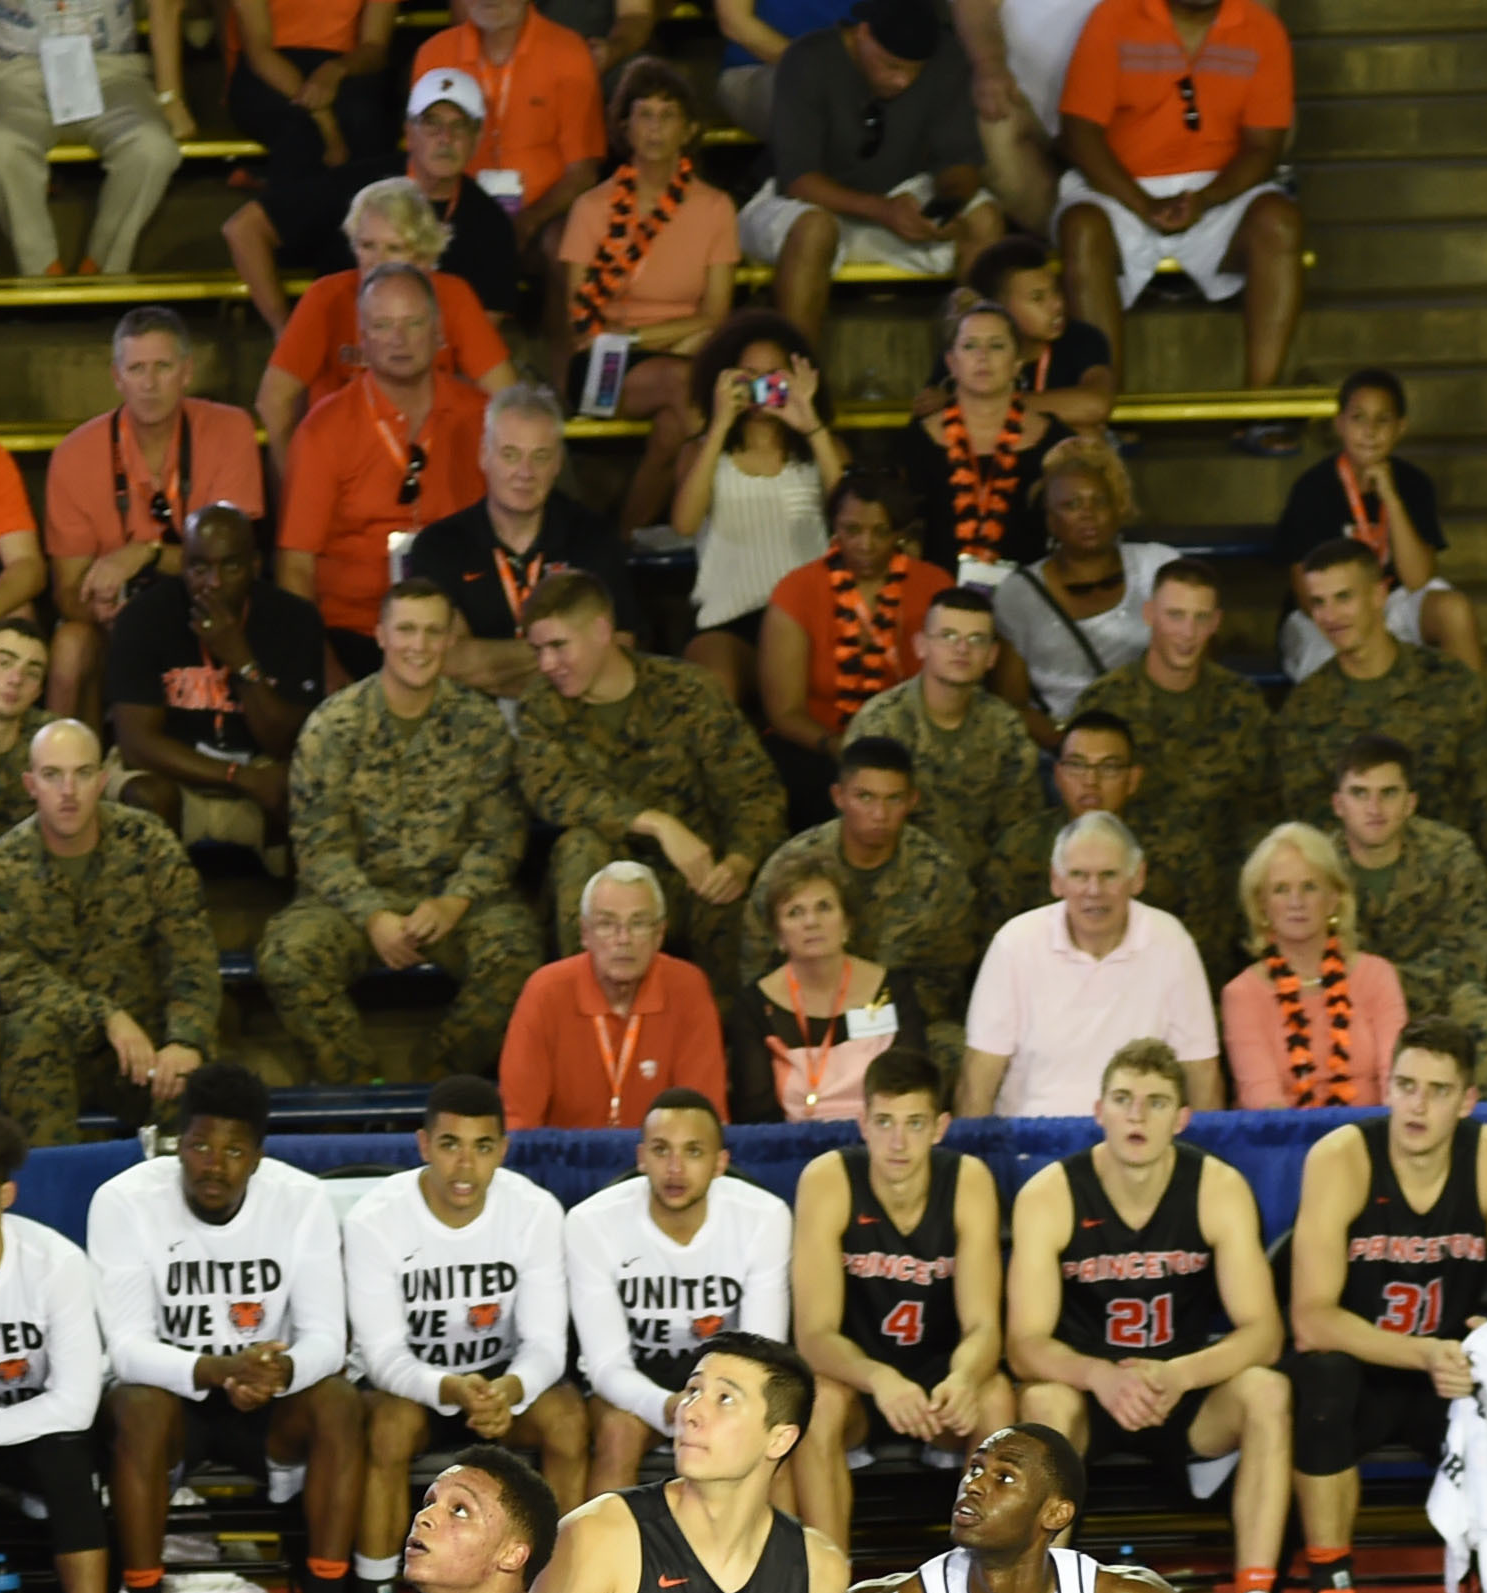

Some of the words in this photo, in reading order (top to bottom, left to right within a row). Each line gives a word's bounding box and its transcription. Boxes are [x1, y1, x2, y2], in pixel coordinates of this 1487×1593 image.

[1349, 1233, 1487, 1263] PRNCETON
[167, 1258, 282, 1296] UNITED
[402, 1261, 517, 1303] UNITED
[1063, 1250, 1209, 1283] PRINCETON
[616, 1275, 744, 1310] UNITED
[1376, 1277, 1443, 1335] 31
[162, 1304, 214, 1338] WE
[407, 1309, 448, 1338] WE
[881, 1300, 925, 1346] 4
[1106, 1293, 1173, 1348] 21
[408, 1336, 503, 1367] TAND
